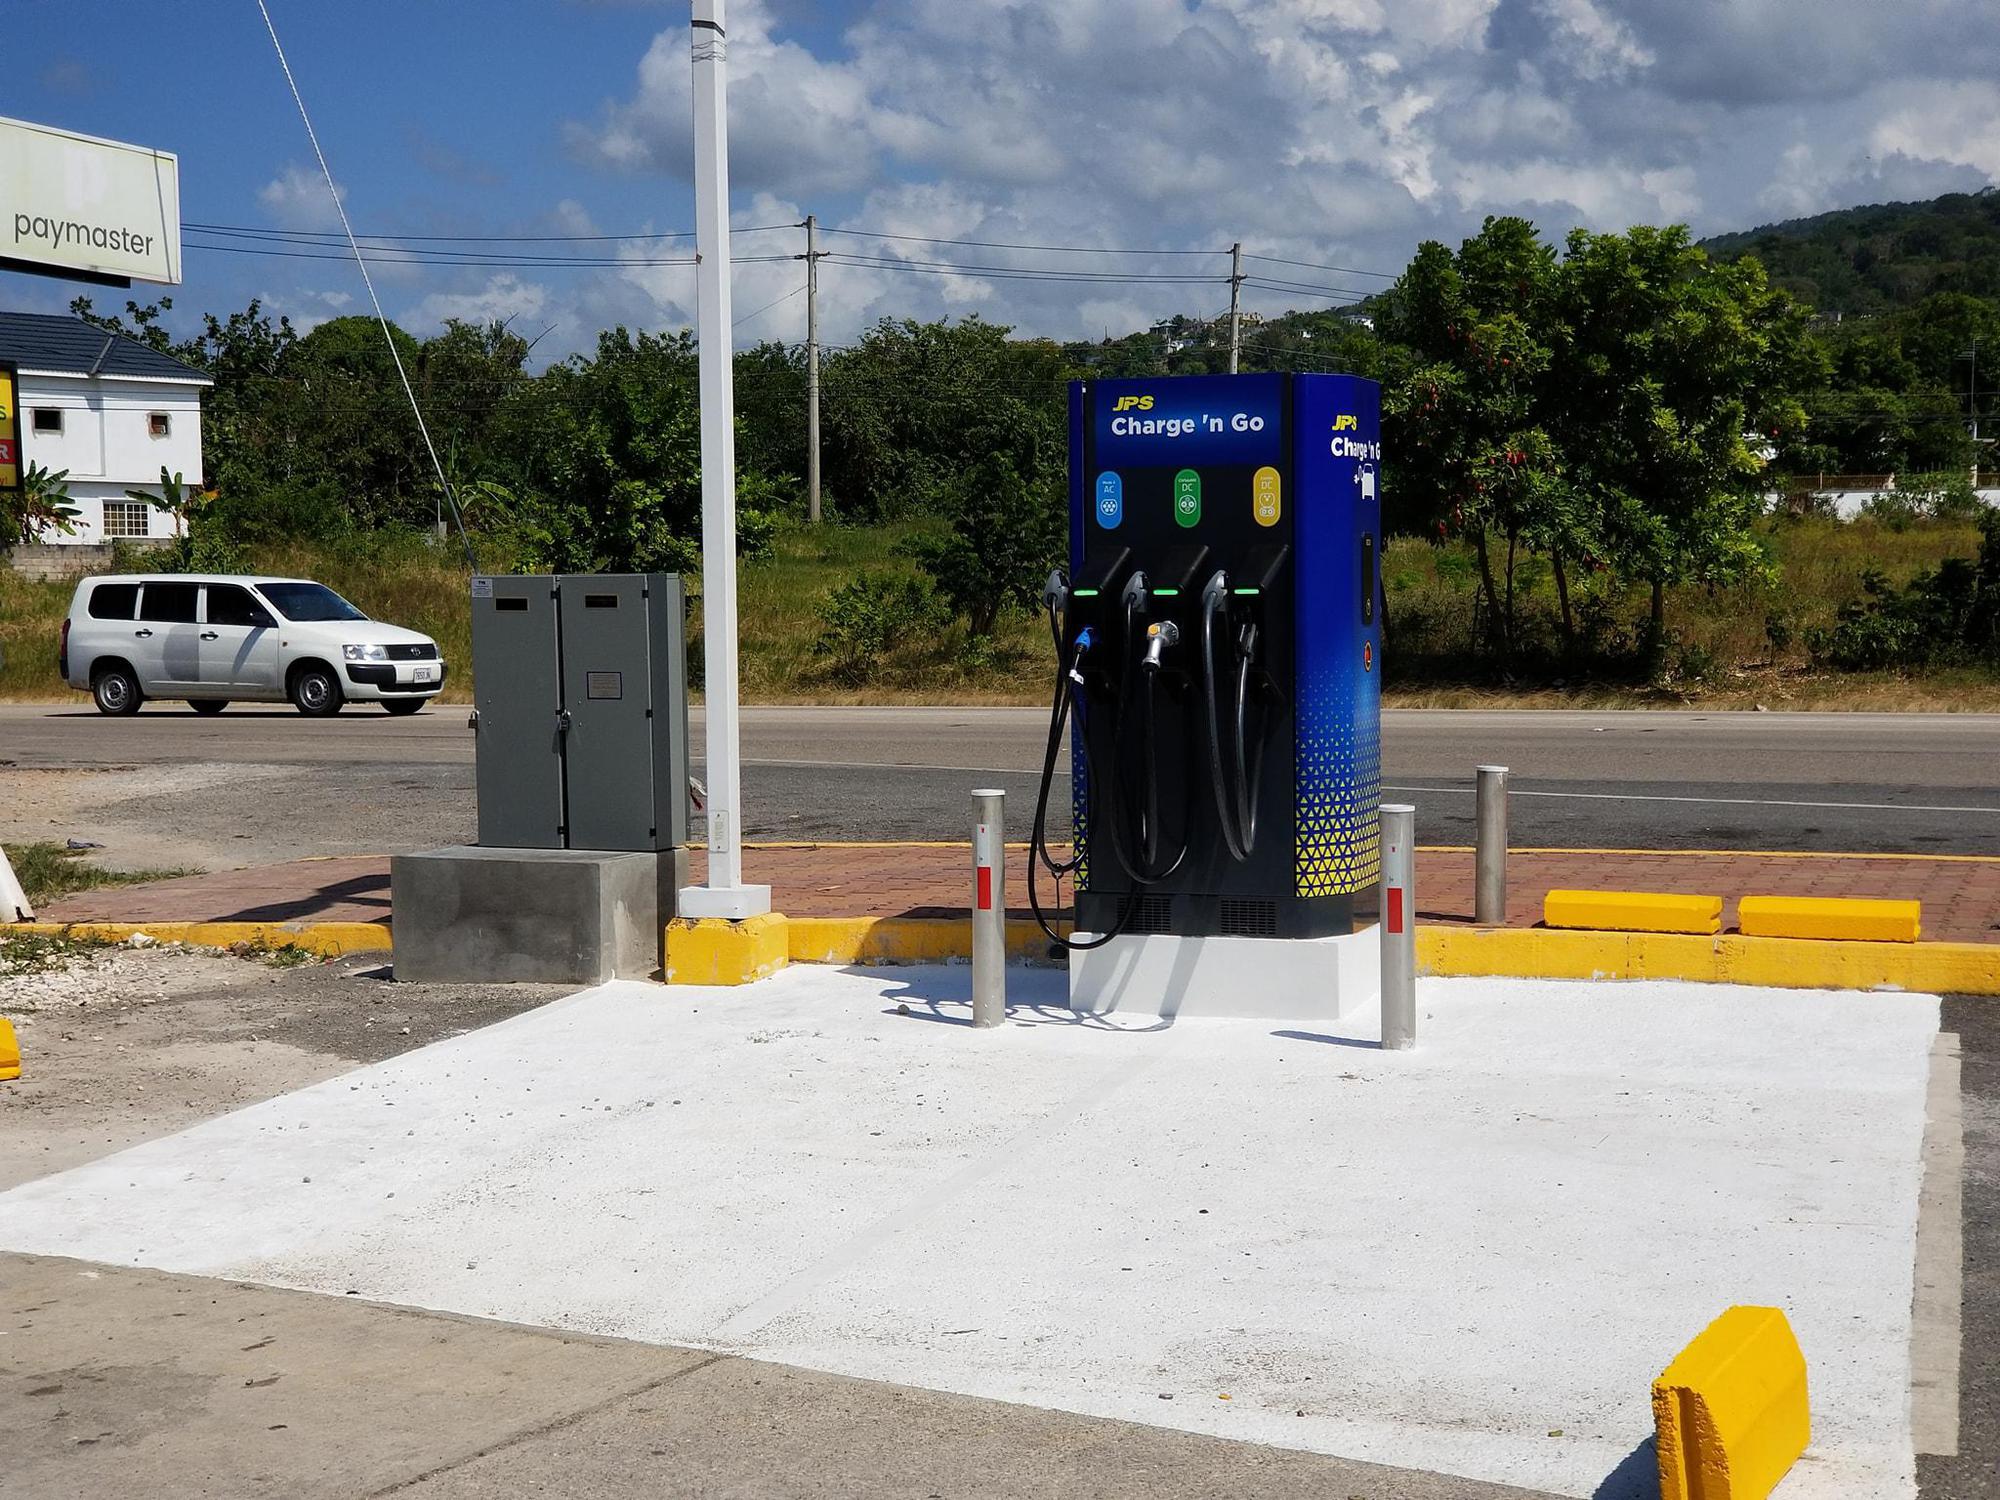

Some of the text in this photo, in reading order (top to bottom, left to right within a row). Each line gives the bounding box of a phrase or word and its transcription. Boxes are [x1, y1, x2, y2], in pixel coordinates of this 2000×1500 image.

[15, 212, 153, 256] paymaster
[1112, 395, 1154, 412] JPS
[1111, 413, 1265, 437] Charge 'n Go
[1331, 415, 1357, 431] JPS
[1331, 437, 1367, 461] Charge
[1103, 485, 1115, 494] AC
[1181, 483, 1193, 491] DC
[1261, 480, 1273, 490] DC
